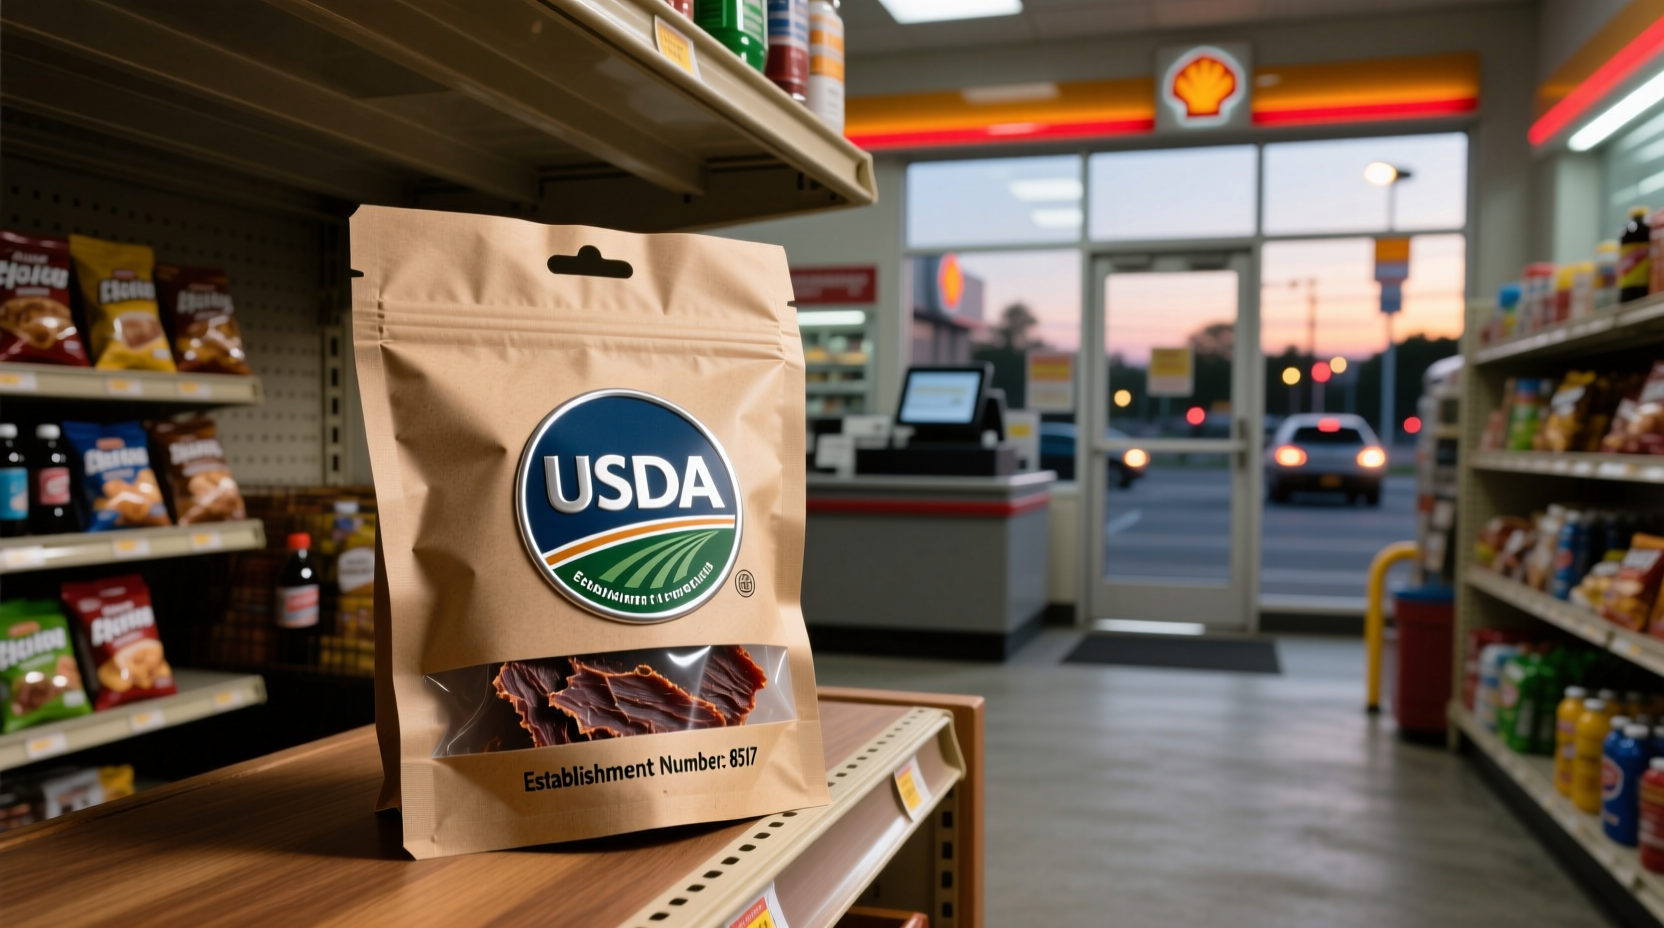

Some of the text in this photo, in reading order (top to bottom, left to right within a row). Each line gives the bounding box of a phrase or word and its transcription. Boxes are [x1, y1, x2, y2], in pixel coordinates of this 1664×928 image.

[543, 454, 726, 513] USDA
[523, 746, 758, 792] Establishment Number: 8517
